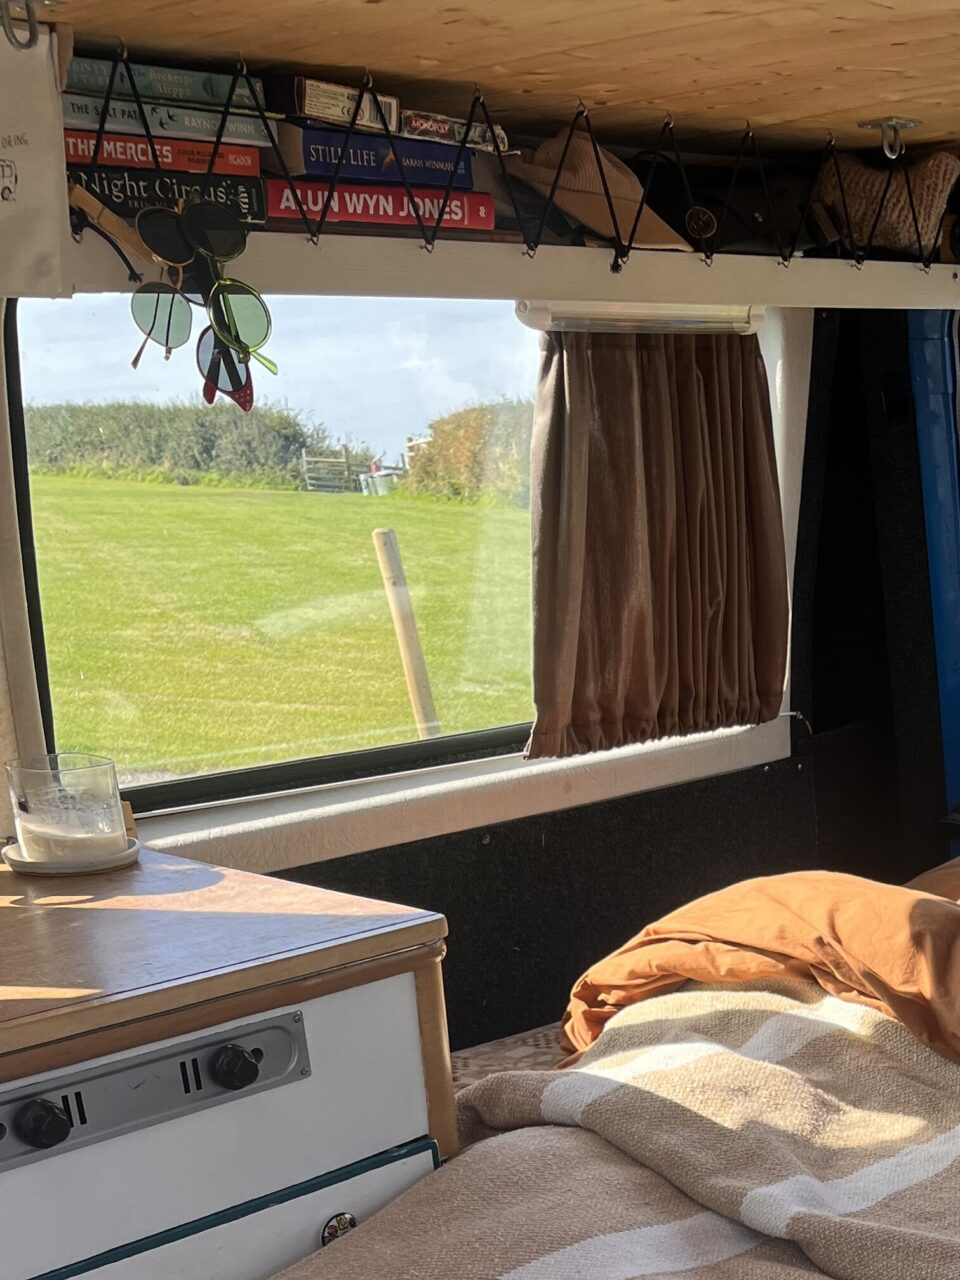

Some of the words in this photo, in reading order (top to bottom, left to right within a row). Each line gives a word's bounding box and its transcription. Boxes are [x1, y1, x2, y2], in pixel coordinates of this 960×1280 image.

[70, 102, 90, 115] THE
[94, 105, 117, 119] SLT
[120, 109, 142, 121] PAT
[184, 116, 220, 131] RAYNO
[226, 121, 256, 135] WINN
[410, 118, 450, 135] MONOPOLY
[66, 137, 97, 157] THE
[102, 140, 173, 163] MERCIES
[310, 144, 346, 165] STILL
[349, 149, 376, 167] LIFE
[402, 157, 424, 168] SARAH
[424, 159, 454, 172] WINMAN
[77, 171, 147, 203] Night
[279, 187, 338, 213] ALUN
[343, 192, 393, 217] WYN
[398, 194, 463, 222] JONES
